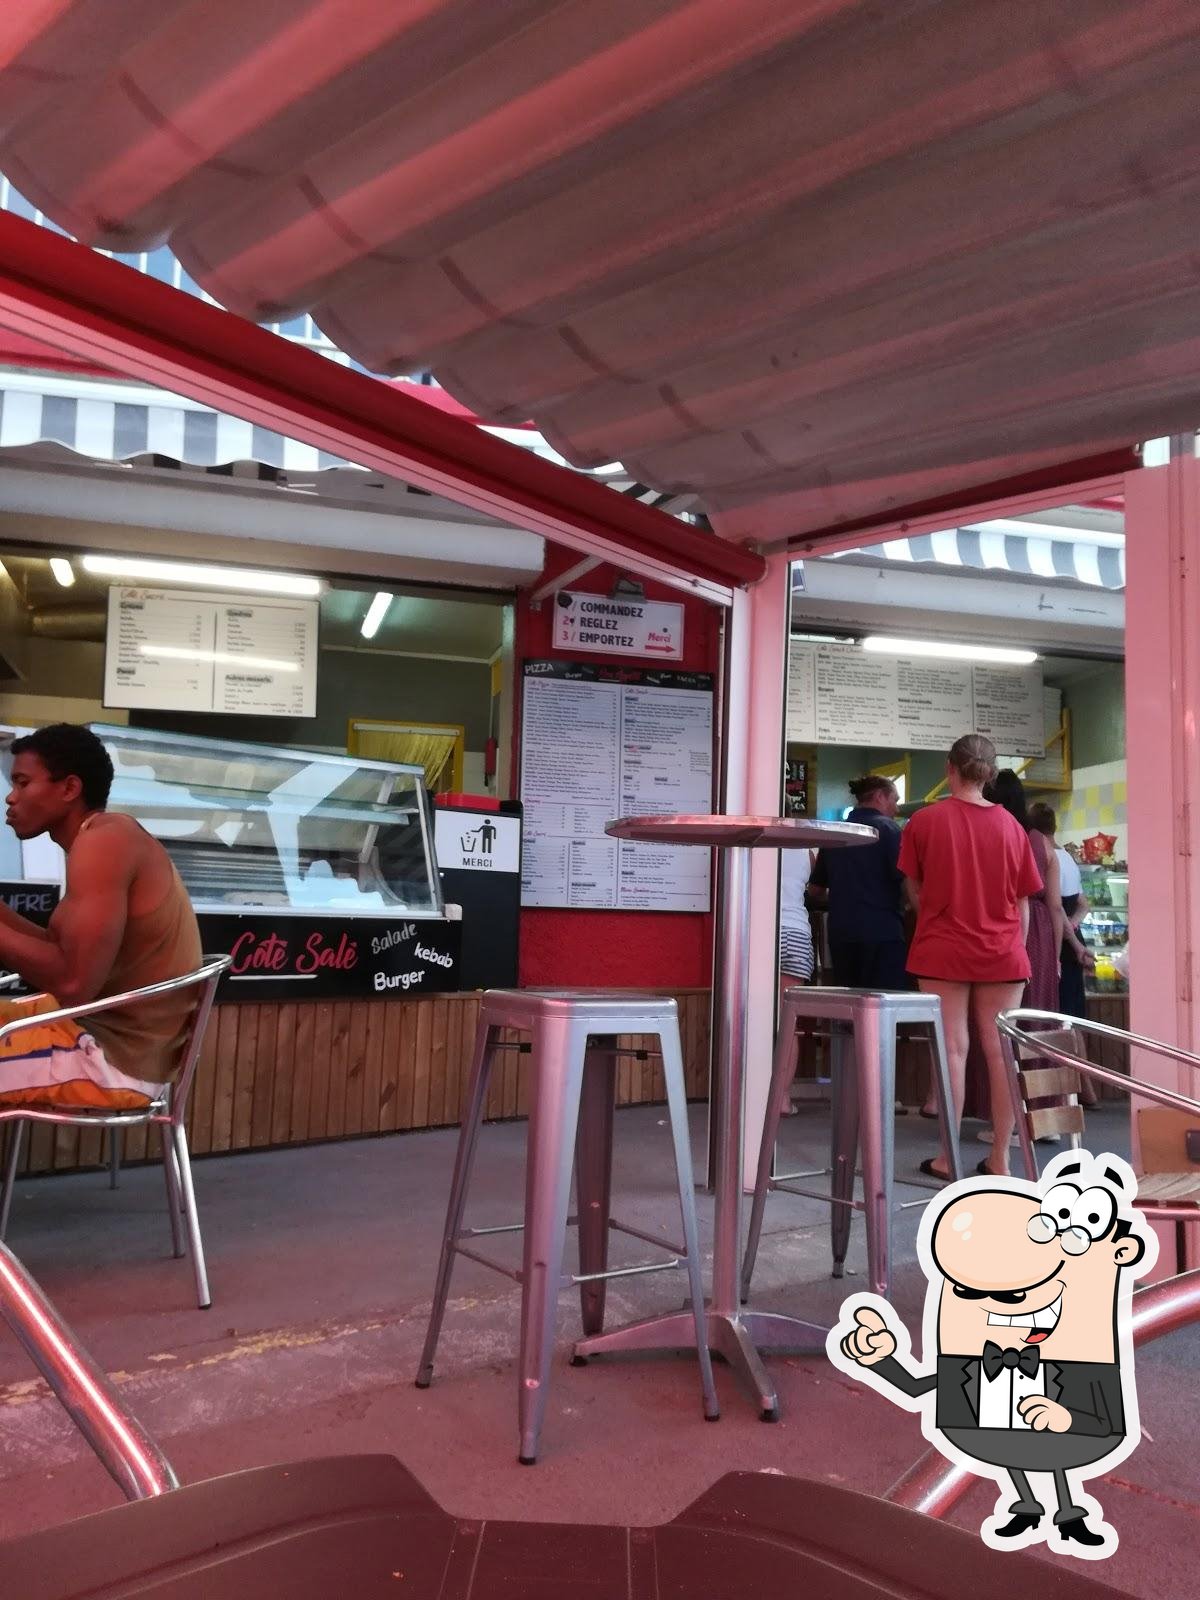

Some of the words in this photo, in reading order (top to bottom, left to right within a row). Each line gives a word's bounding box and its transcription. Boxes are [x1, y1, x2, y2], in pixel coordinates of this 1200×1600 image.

[580, 601, 644, 618] COMMANDEZ
[580, 616, 619, 630] REGLEZ
[579, 632, 635, 647] EMPORTEZ
[647, 632, 672, 643] Merci
[524, 662, 554, 674] PIZZA
[462, 857, 493, 868] MERCI
[370, 921, 419, 955] Salade
[295, 930, 359, 974] Salé
[413, 942, 455, 969] kebab
[373, 968, 426, 992] Burger
